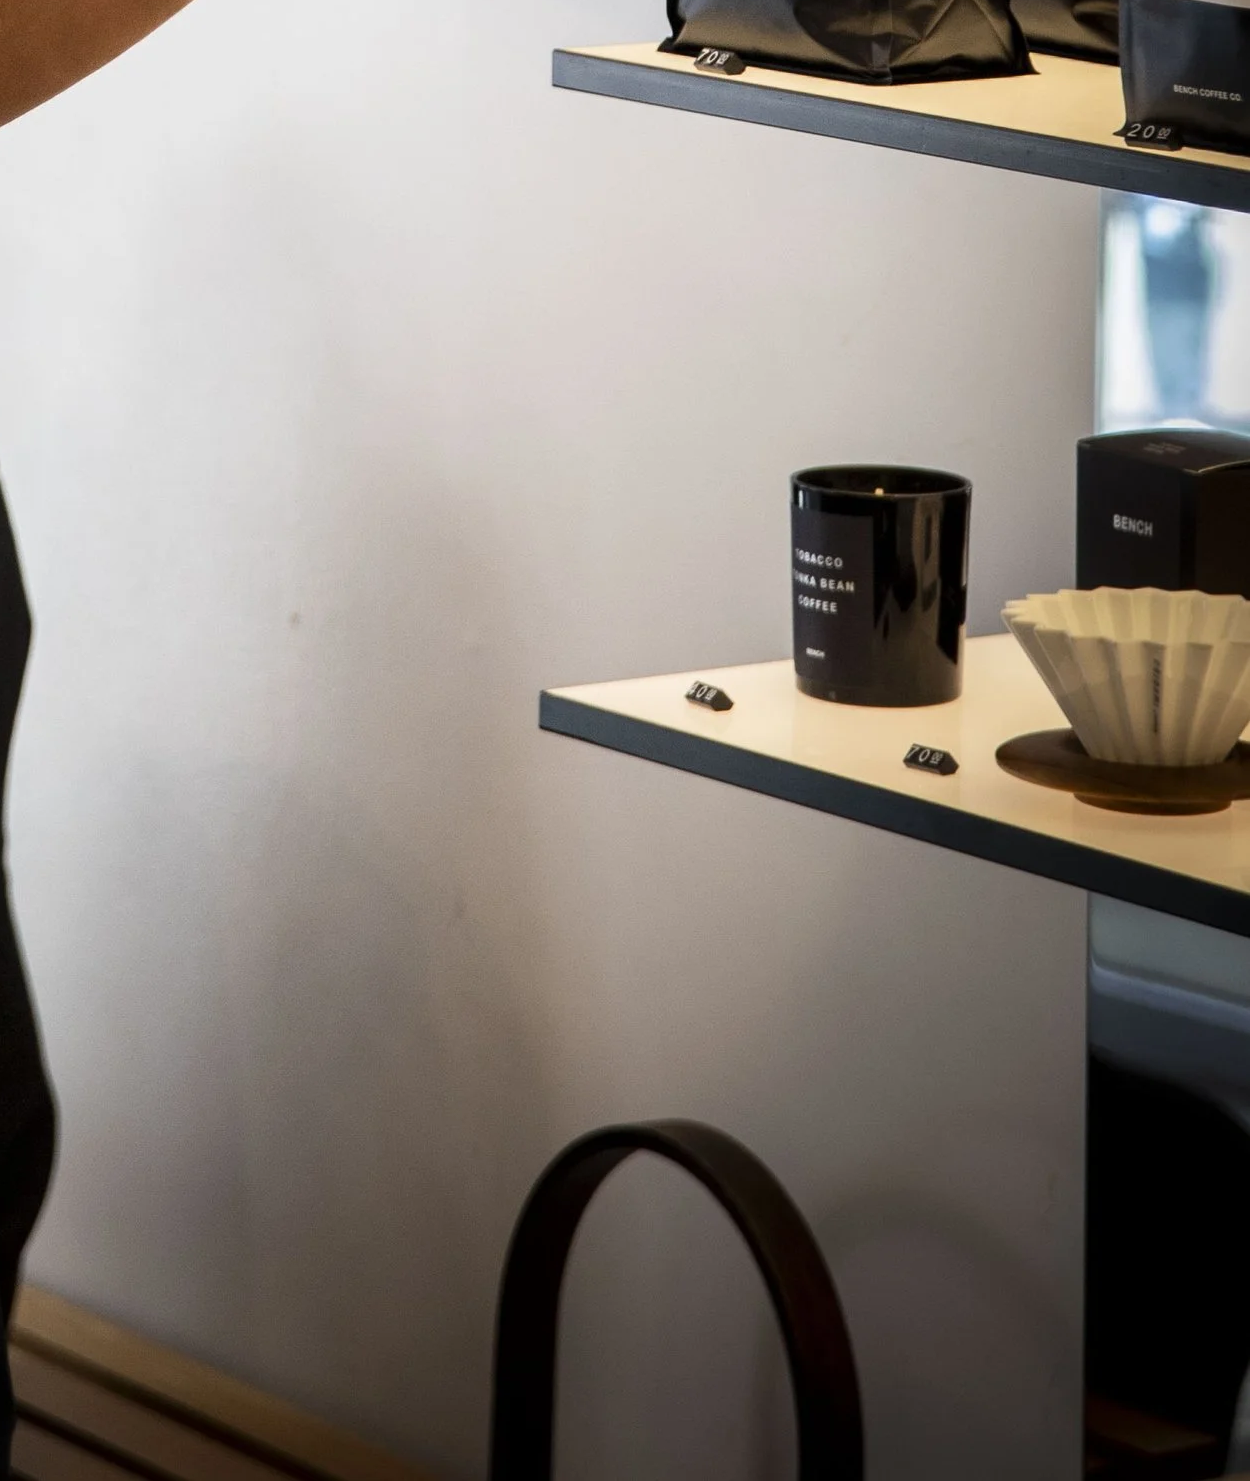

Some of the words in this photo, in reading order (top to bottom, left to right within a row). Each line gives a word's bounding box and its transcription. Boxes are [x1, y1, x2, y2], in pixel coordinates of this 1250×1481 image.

[697, 47, 718, 64] 70
[1173, 84, 1198, 95] BENCH
[1199, 88, 1228, 100] COFFEE
[1230, 93, 1243, 101] CO.
[1127, 123, 1155, 139] 20
[1113, 514, 1153, 536] BENCH
[795, 548, 843, 568] TOBACCO
[820, 578, 855, 593] BEAN
[798, 594, 838, 613] COFFEE
[906, 746, 930, 762] 70
